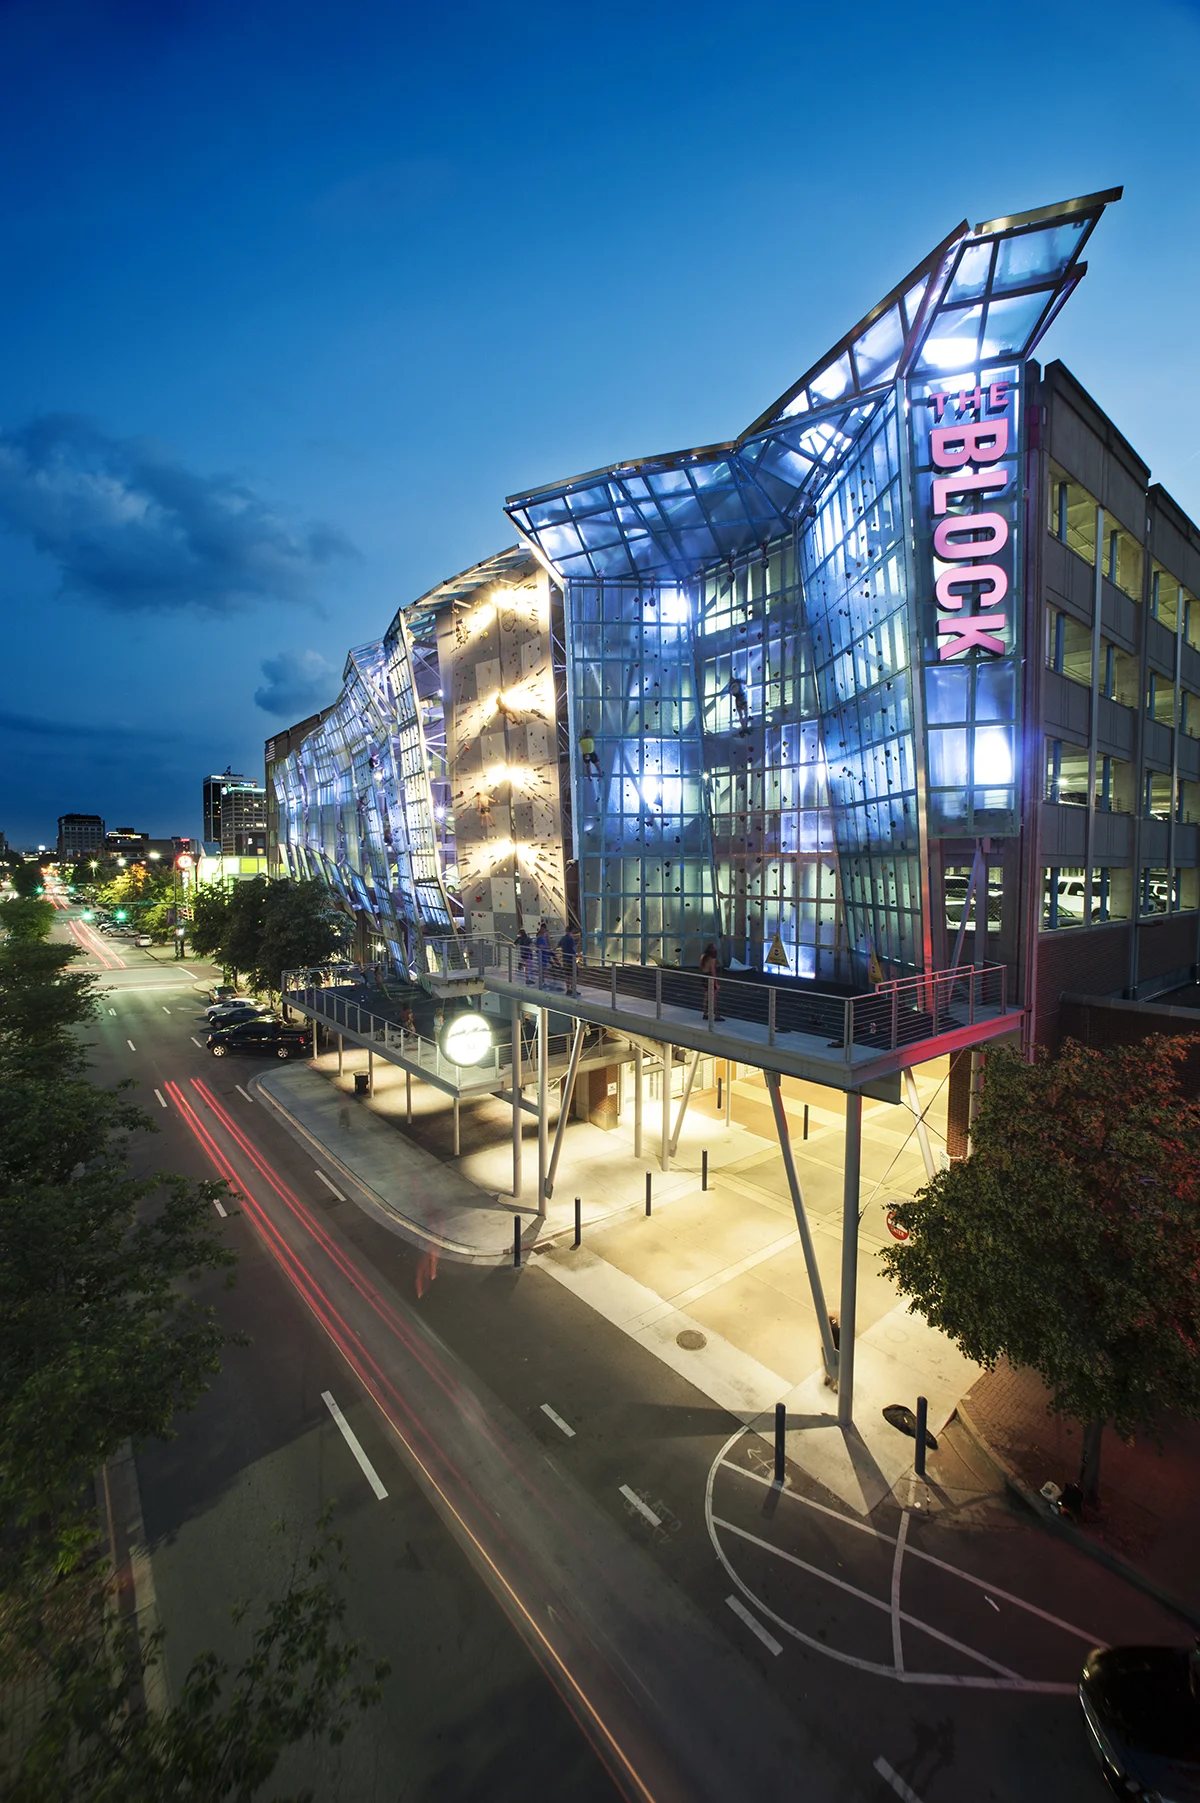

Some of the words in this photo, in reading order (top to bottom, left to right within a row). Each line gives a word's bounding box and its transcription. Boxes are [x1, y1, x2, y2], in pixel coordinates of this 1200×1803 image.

[929, 381, 1009, 416] THE
[931, 418, 1008, 661] BLOCK
[890, 1226, 904, 1237] ENTER
